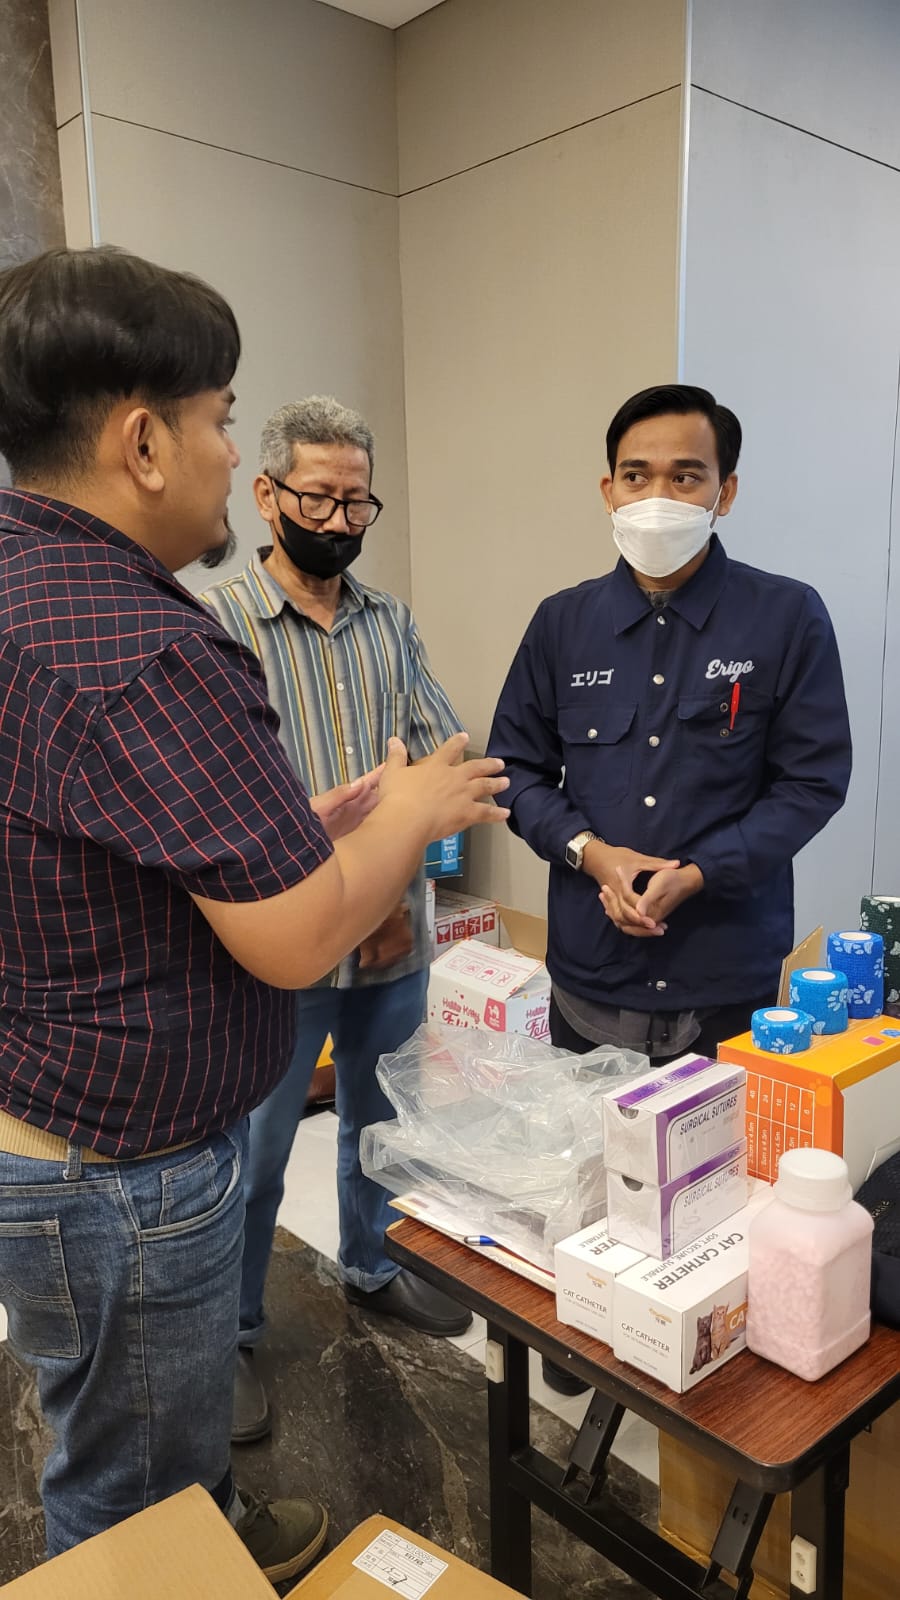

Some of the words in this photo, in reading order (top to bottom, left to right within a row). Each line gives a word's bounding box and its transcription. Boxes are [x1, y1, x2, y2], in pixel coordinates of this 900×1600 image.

[571, 669, 614, 687] エリゴ
[705, 659, 754, 683] Erigo
[680, 1111, 710, 1135] SURGICAL
[711, 1095, 738, 1121] SUTURES
[683, 1181, 713, 1208] SURGICAL
[713, 1165, 740, 1190] SUTURES
[719, 1232, 744, 1251] CAT
[640, 1259, 674, 1282] SUITABLE
[653, 1248, 719, 1290] CATHETER
[563, 1288, 576, 1299] CAT
[575, 1294, 607, 1313] CATHETER
[621, 1322, 635, 1334] CAT
[635, 1330, 670, 1353] CATHETER
